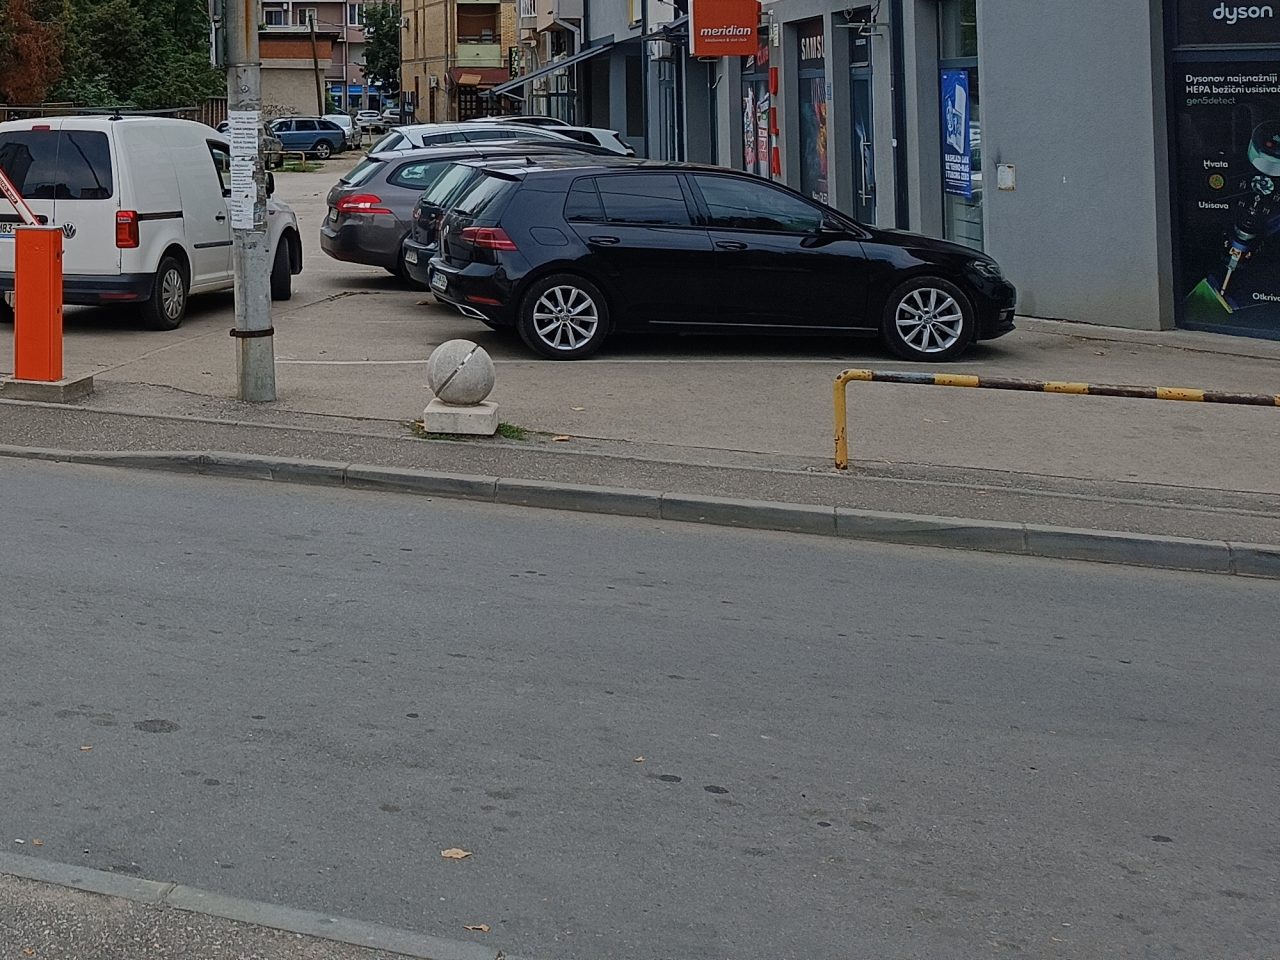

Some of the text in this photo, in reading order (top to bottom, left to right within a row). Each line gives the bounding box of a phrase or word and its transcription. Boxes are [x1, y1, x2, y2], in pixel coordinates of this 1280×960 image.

[1212, 2, 1273, 25] dyson
[700, 25, 752, 36] meridian
[1185, 73, 1278, 85] Dysonov najsnažniji
[1185, 85, 1211, 94] HEPA
[1212, 85, 1245, 94] bežični
[1198, 201, 1229, 209] Usisava
